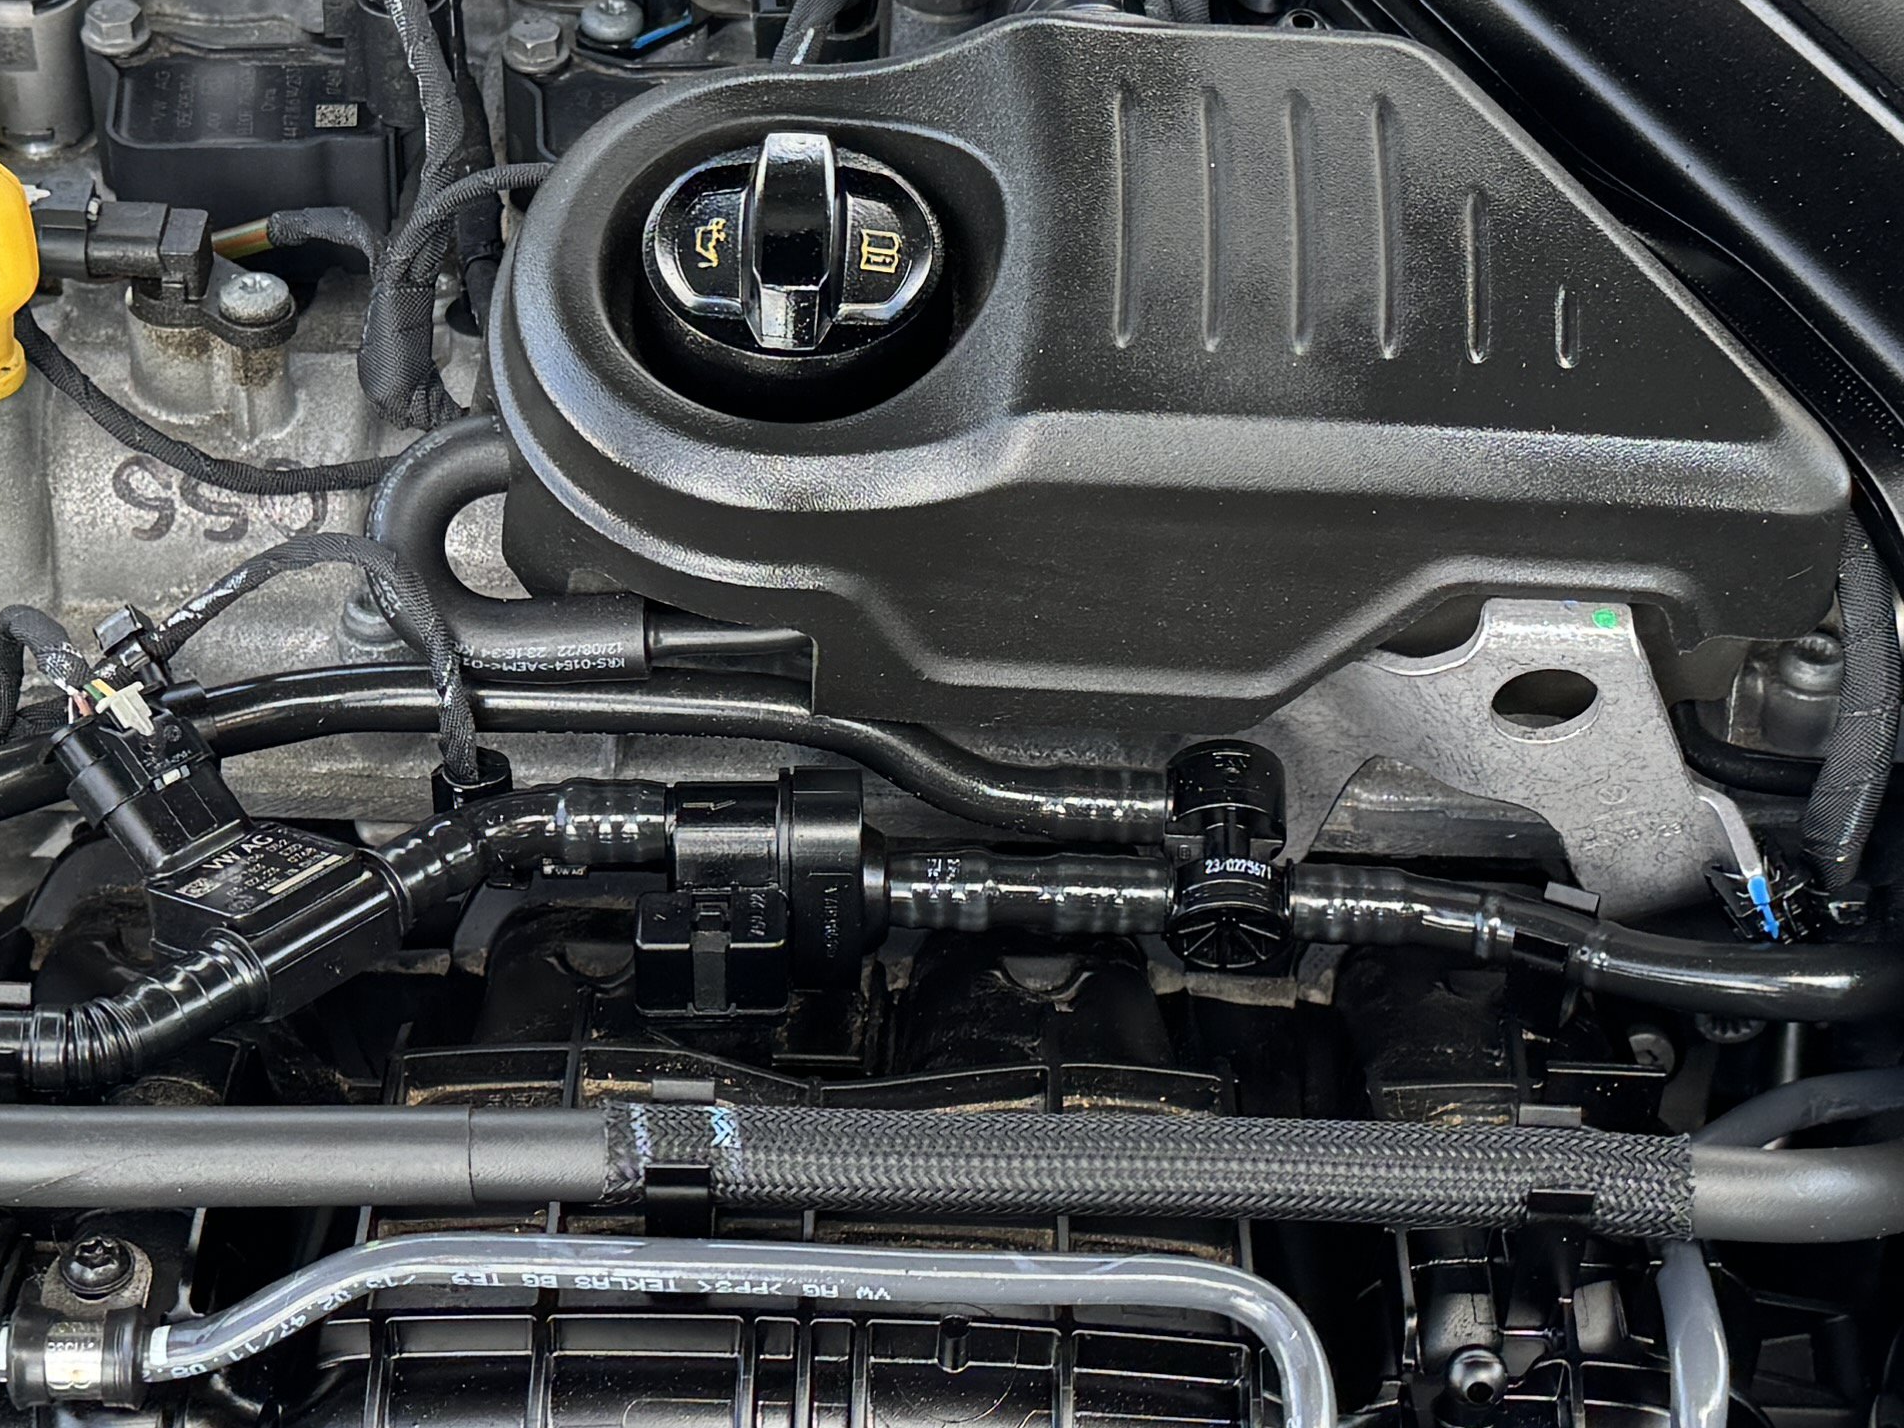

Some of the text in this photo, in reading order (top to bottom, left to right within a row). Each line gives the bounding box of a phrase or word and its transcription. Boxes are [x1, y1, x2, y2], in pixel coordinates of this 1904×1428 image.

[203, 851, 239, 873] VW
[240, 834, 274, 856] AG
[521, 1271, 558, 1288] BG
[573, 1274, 680, 1292] TEKLAS
[801, 1282, 839, 1298] AG
[854, 1285, 891, 1300] VW
